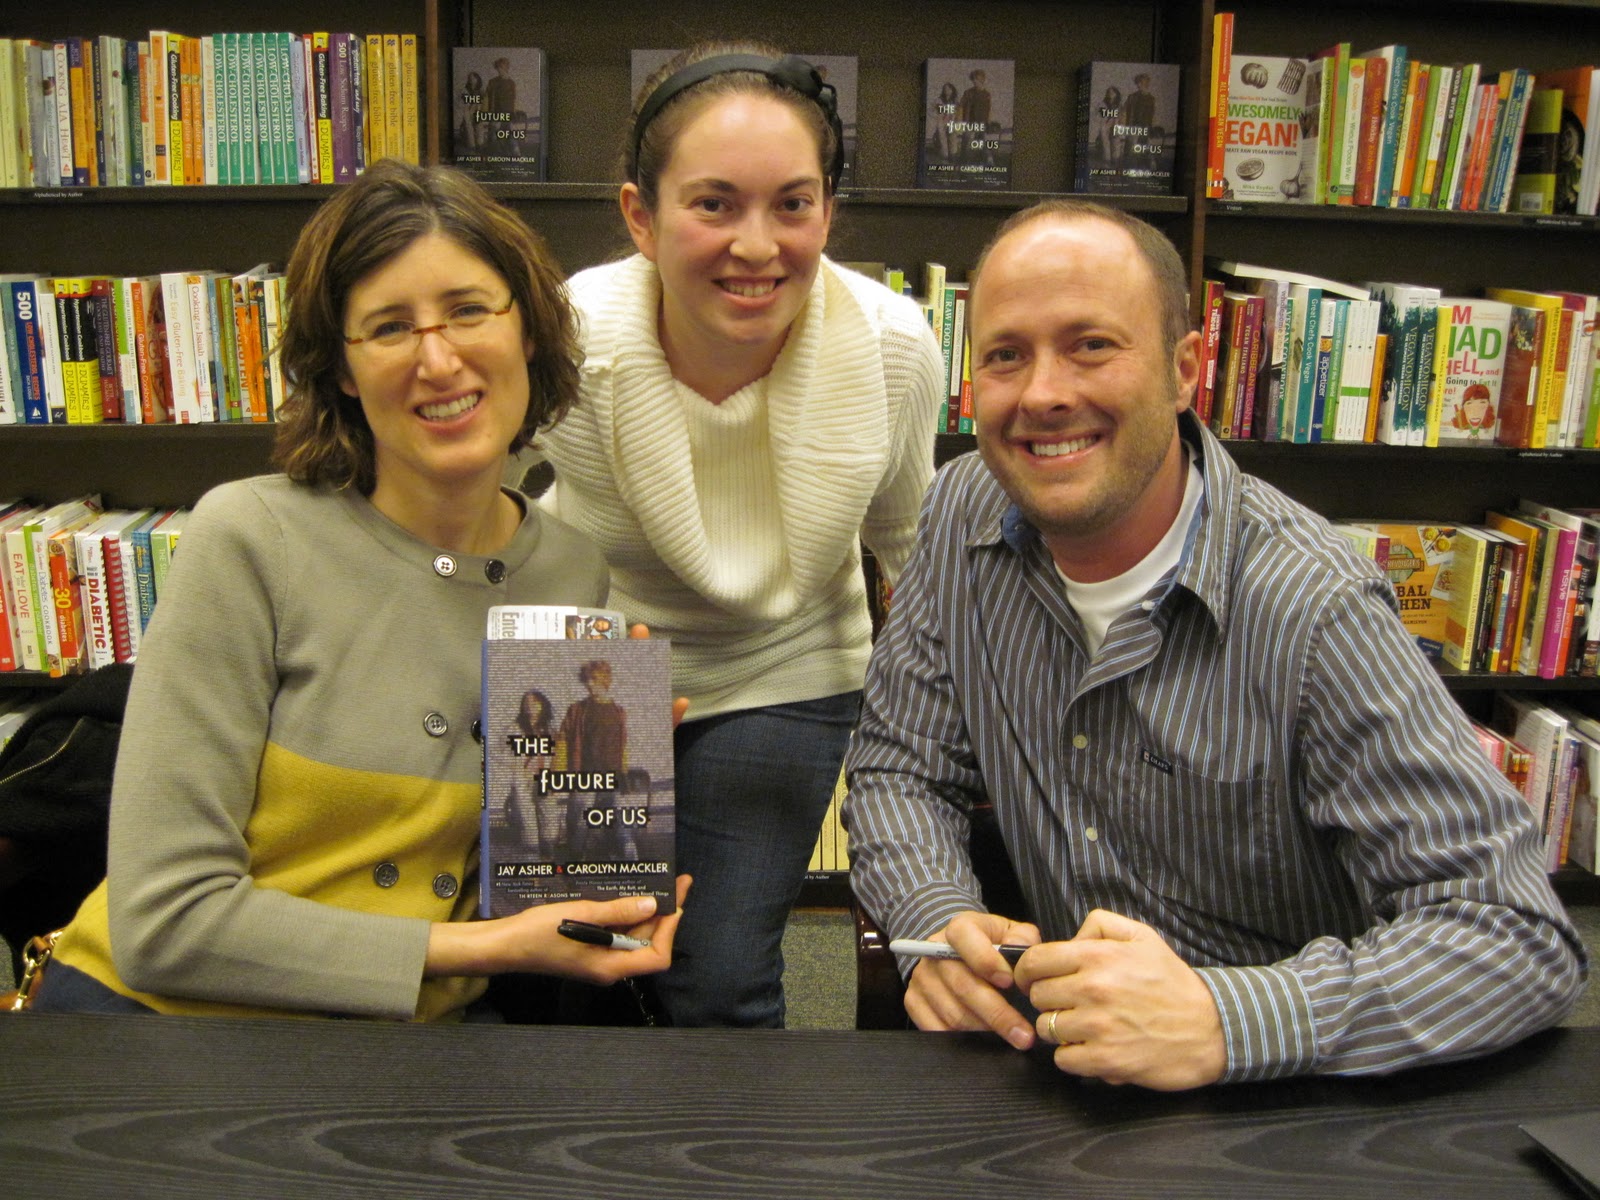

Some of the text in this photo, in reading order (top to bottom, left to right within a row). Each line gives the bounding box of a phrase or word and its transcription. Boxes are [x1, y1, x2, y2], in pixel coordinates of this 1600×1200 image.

[338, 42, 347, 59] 500
[169, 53, 180, 121] Gluten-Free Cooking
[214, 47, 227, 145] LOW-CHOLESTEROL
[227, 47, 240, 145] LOW-CHOLESTEROL
[240, 47, 253, 145] LOW-CHOLESTEROL
[254, 47, 269, 145] LOW-CHOLESTEROL
[267, 47, 282, 145] LOW-CHOLESTEROL
[280, 47, 295, 145] LOW-CHOLESTEROL
[317, 53, 328, 118] Gluten-Free Baking
[388, 62, 397, 105] gluten-free
[405, 62, 415, 105] gluten-free
[464, 95, 480, 103] THE
[1386, 56, 1402, 145] Great Chefs Cook Vegan
[1448, 69, 1462, 119] VEGAN BITES
[56, 52, 71, 160] COOKING HEART
[373, 107, 382, 127] bible
[390, 107, 398, 127] bible
[407, 107, 416, 127] bible
[938, 104, 955, 114] THE
[1101, 109, 1119, 118] THE
[1227, 104, 1300, 120] WESOMELY
[182, 121, 191, 142] gluten
[193, 121, 202, 142] gluten
[497, 130, 526, 139] OF US
[971, 140, 999, 150] OF US
[1216, 128, 1224, 148] VEGAN
[1225, 121, 1298, 148] EGAN!
[1368, 117, 1379, 143] Holiday
[172, 127, 182, 171] DUMMIES
[320, 127, 331, 170] DUMMIES
[1133, 144, 1162, 154] OF US
[17, 291, 33, 321] 500
[74, 299, 82, 333] Hypertension
[170, 302, 178, 321] Easy
[191, 286, 203, 321] Cooking
[945, 301, 953, 321] RAW
[1278, 290, 1287, 334] wholesome
[60, 299, 71, 361] Hypertension Cookbook
[172, 322, 184, 366] Gluten-Free
[195, 332, 205, 357] Isaiah
[944, 322, 952, 347] FOOD
[1284, 309, 1292, 346] VEGAN
[1302, 298, 1319, 384] Great Chefs Cook Vegan
[27, 335, 37, 375] CHOLESTEROL
[137, 333, 151, 409] Gluten-Free Cookbook
[1239, 346, 1249, 374] ITALIANO
[1401, 326, 1418, 411] VEGANOMICON
[1418, 326, 1435, 411] VEGANOMICON
[1485, 368, 1499, 376] and
[1540, 306, 1560, 417] MEDITERRANEAN HARVEST
[31, 376, 41, 400] RECIPES
[66, 369, 77, 411] DUMMIES
[79, 369, 90, 411] DUMMIES
[176, 370, 186, 397] Baking
[1243, 329, 1260, 421] CARIBBEAN VEGAN
[1318, 356, 1331, 398] appetizer
[1446, 377, 1468, 387] Going
[1469, 378, 1477, 386] to
[13, 553, 25, 575] EAT
[54, 587, 72, 609] 30
[138, 573, 151, 616] Diabetic
[1396, 585, 1427, 598] BAL
[1577, 567, 1590, 601] bite size
[17, 589, 30, 619] LOVE
[38, 571, 53, 645] Diabetes COOKBOOK
[88, 578, 107, 649] DIABETIC
[1554, 569, 1570, 635] InStyle parties
[59, 615, 68, 642] diabetes
[502, 612, 520, 639] Ente
[514, 738, 549, 755] THE
[587, 809, 648, 826] OF US
[497, 862, 669, 876] JAY ASHER & CAROLYN MACKLER
